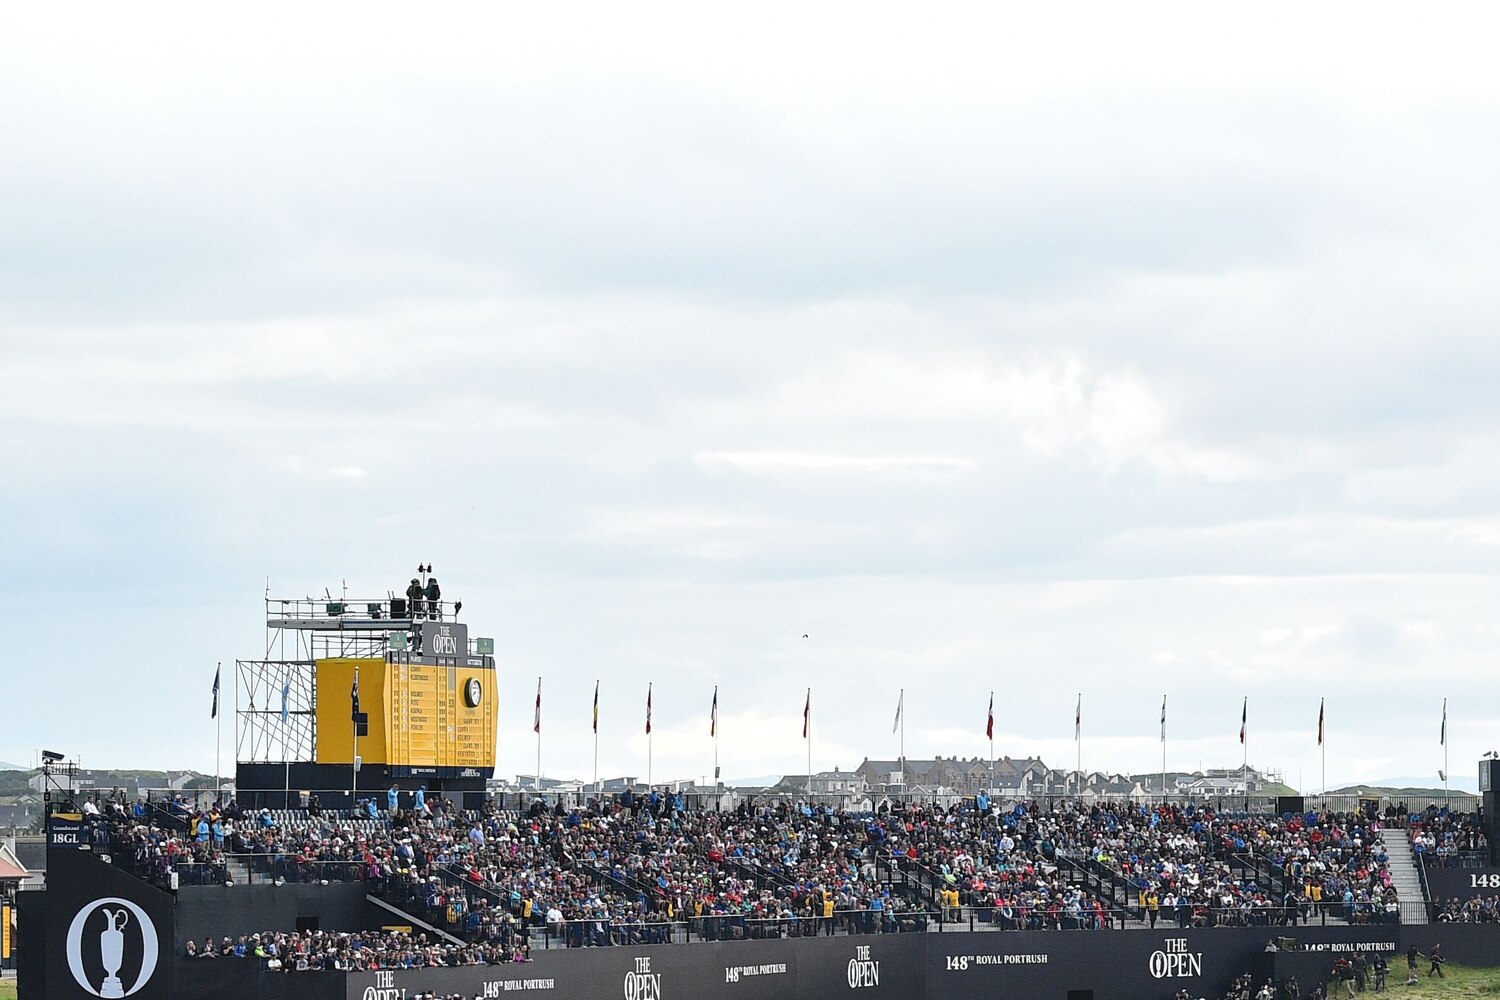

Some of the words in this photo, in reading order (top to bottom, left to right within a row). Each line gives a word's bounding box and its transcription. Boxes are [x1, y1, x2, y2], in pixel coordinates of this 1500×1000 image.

[440, 626, 451, 636] THE
[433, 634, 457, 654] OPEN
[53, 833, 80, 843] 18GL
[856, 945, 870, 960] THE
[1164, 938, 1188, 953] THE
[1331, 943, 1355, 952] ROYAL
[1356, 942, 1395, 951] PORTRUSH
[634, 957, 651, 973] THE
[743, 965, 759, 976] ROYAL
[759, 963, 787, 975] PORTRUSH
[946, 955, 975, 971] 148TH
[976, 955, 1003, 965] ROYAL
[1004, 954, 1048, 964] PORTRUSH
[1149, 950, 1203, 979] OPEN
[375, 970, 394, 988] THE
[847, 958, 879, 989] OPEN
[504, 979, 522, 991] ROYAL
[523, 978, 555, 990] PORTRUSH
